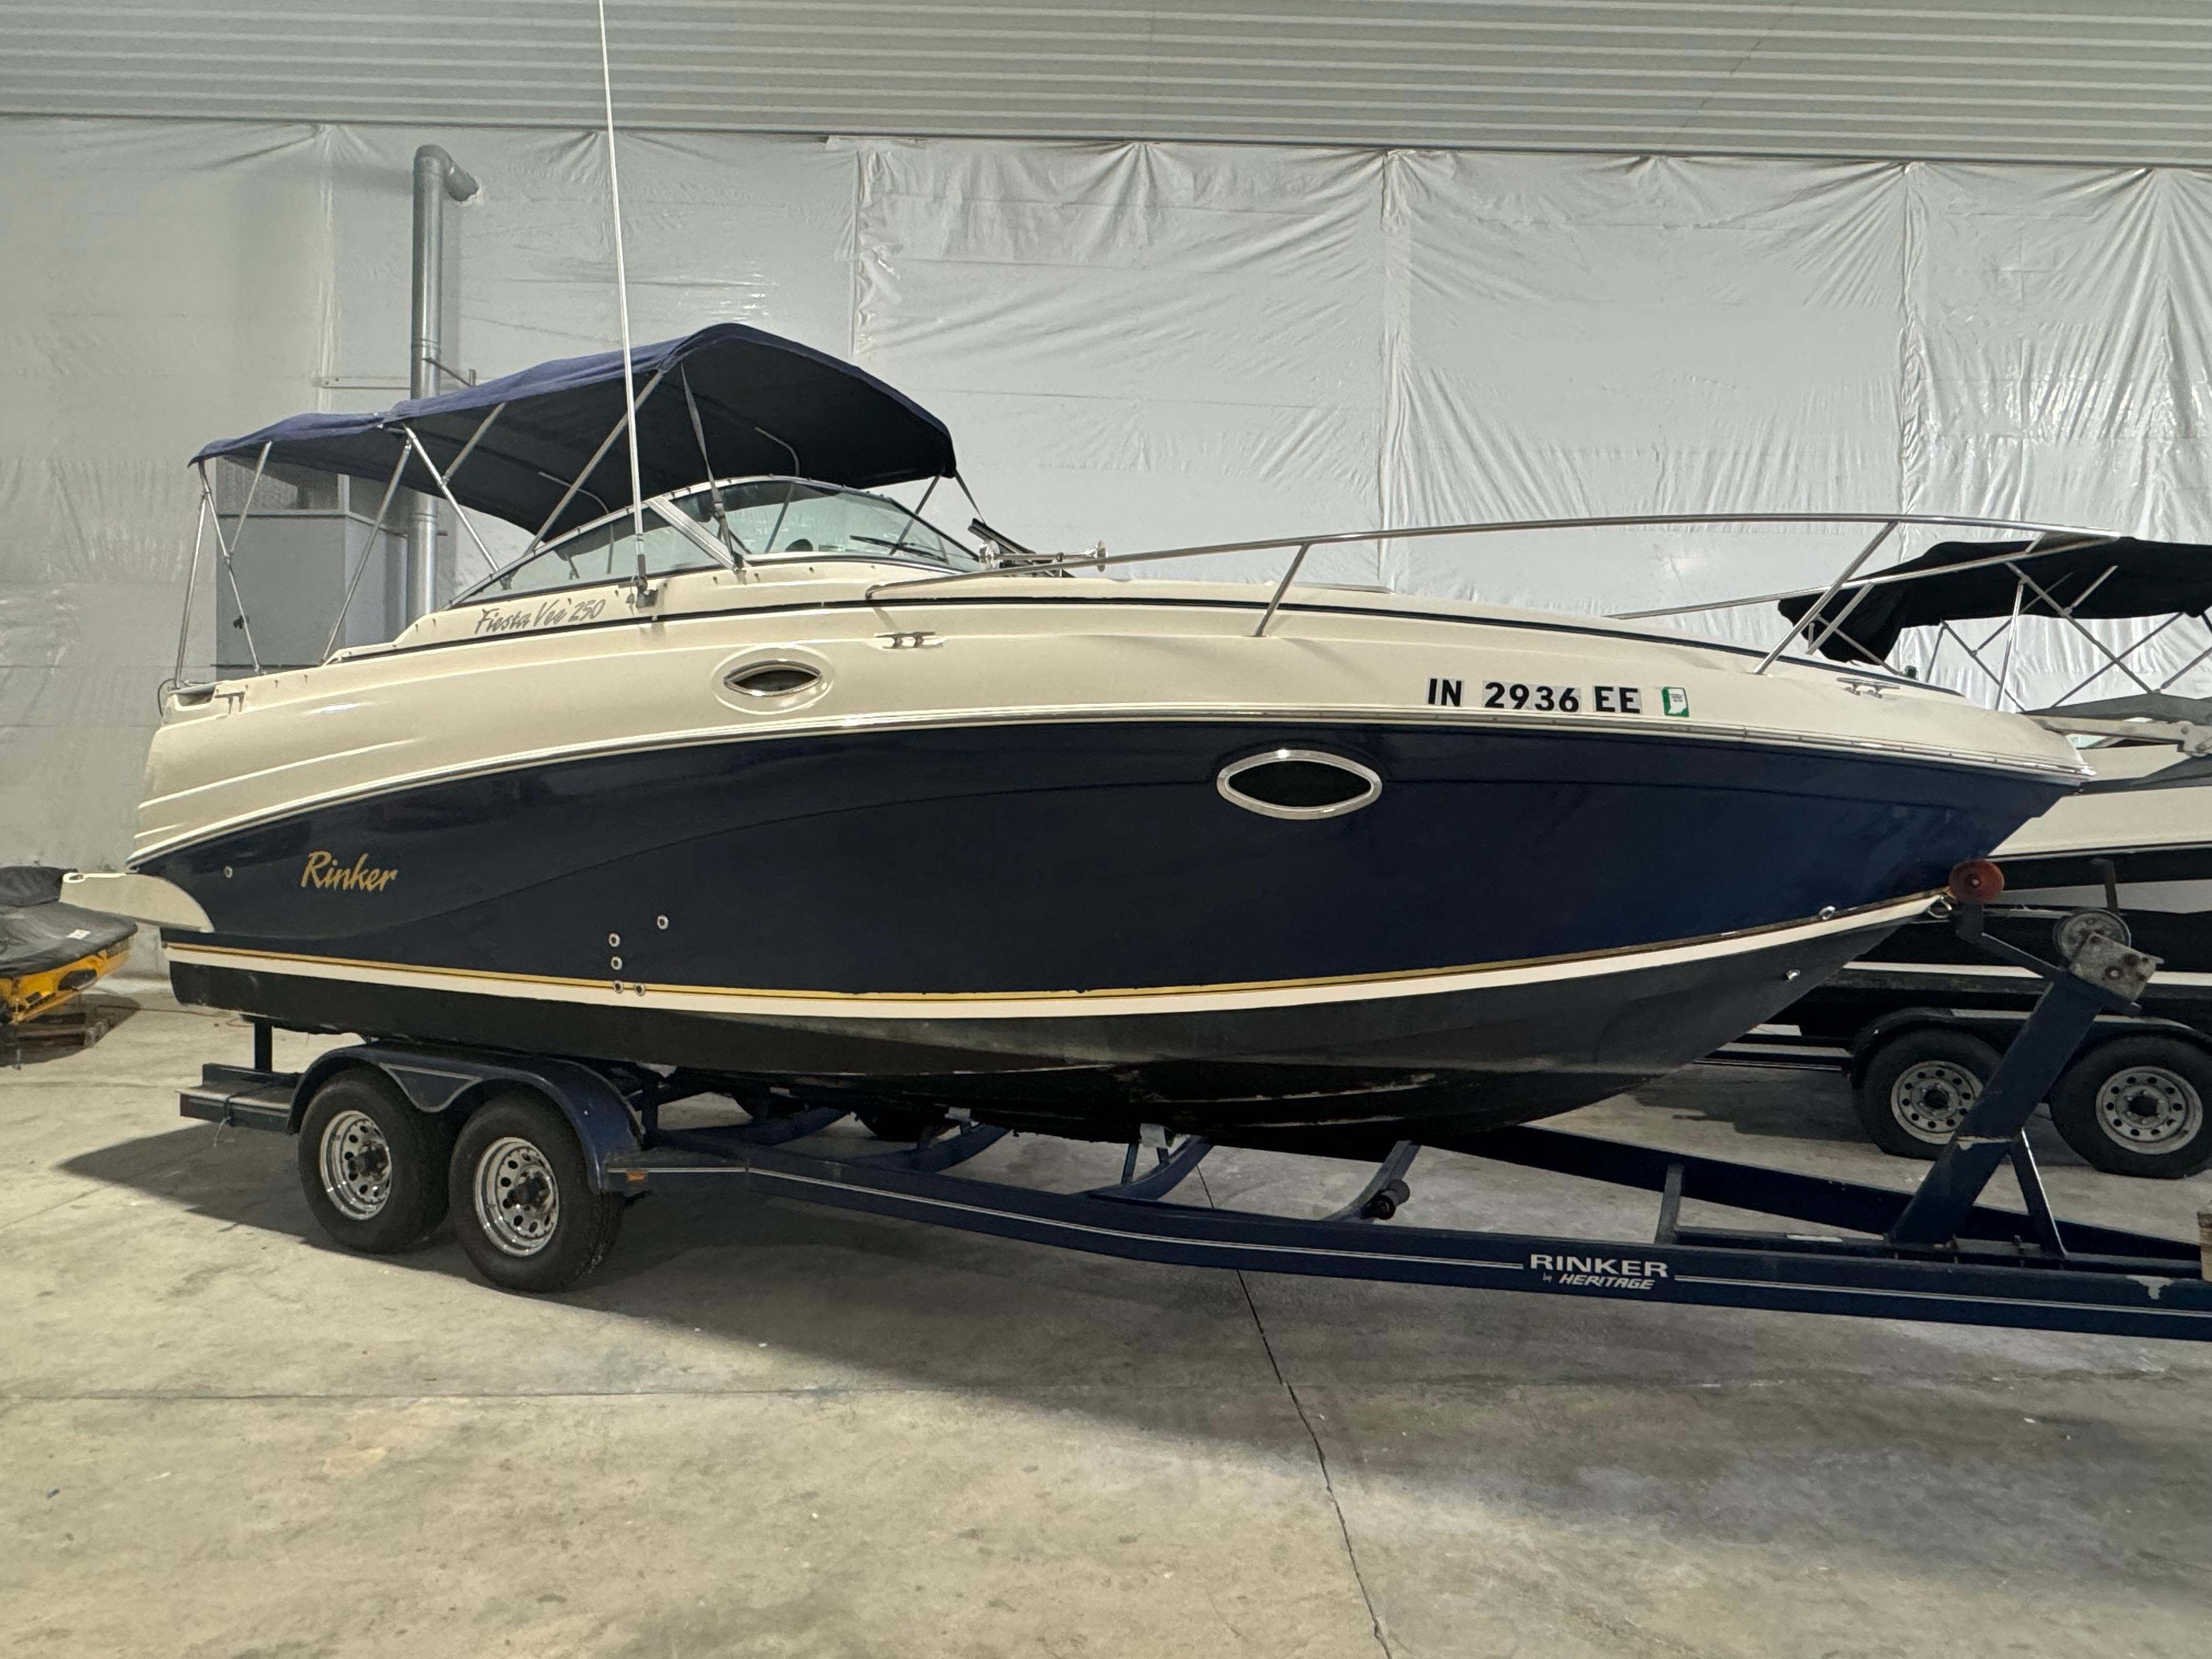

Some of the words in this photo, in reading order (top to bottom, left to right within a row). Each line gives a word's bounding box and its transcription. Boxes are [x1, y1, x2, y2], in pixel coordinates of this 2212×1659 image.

[475, 607, 532, 635] Fiesta
[533, 599, 568, 627] Vee
[567, 599, 606, 623] 250
[1428, 678, 1463, 707] IN
[1484, 682, 1579, 713] 2936
[1594, 686, 1640, 714] EE
[301, 850, 398, 892] Rinker
[1530, 1254, 1668, 1278] RINKER
[1559, 1273, 1656, 1290] HERITAGE
